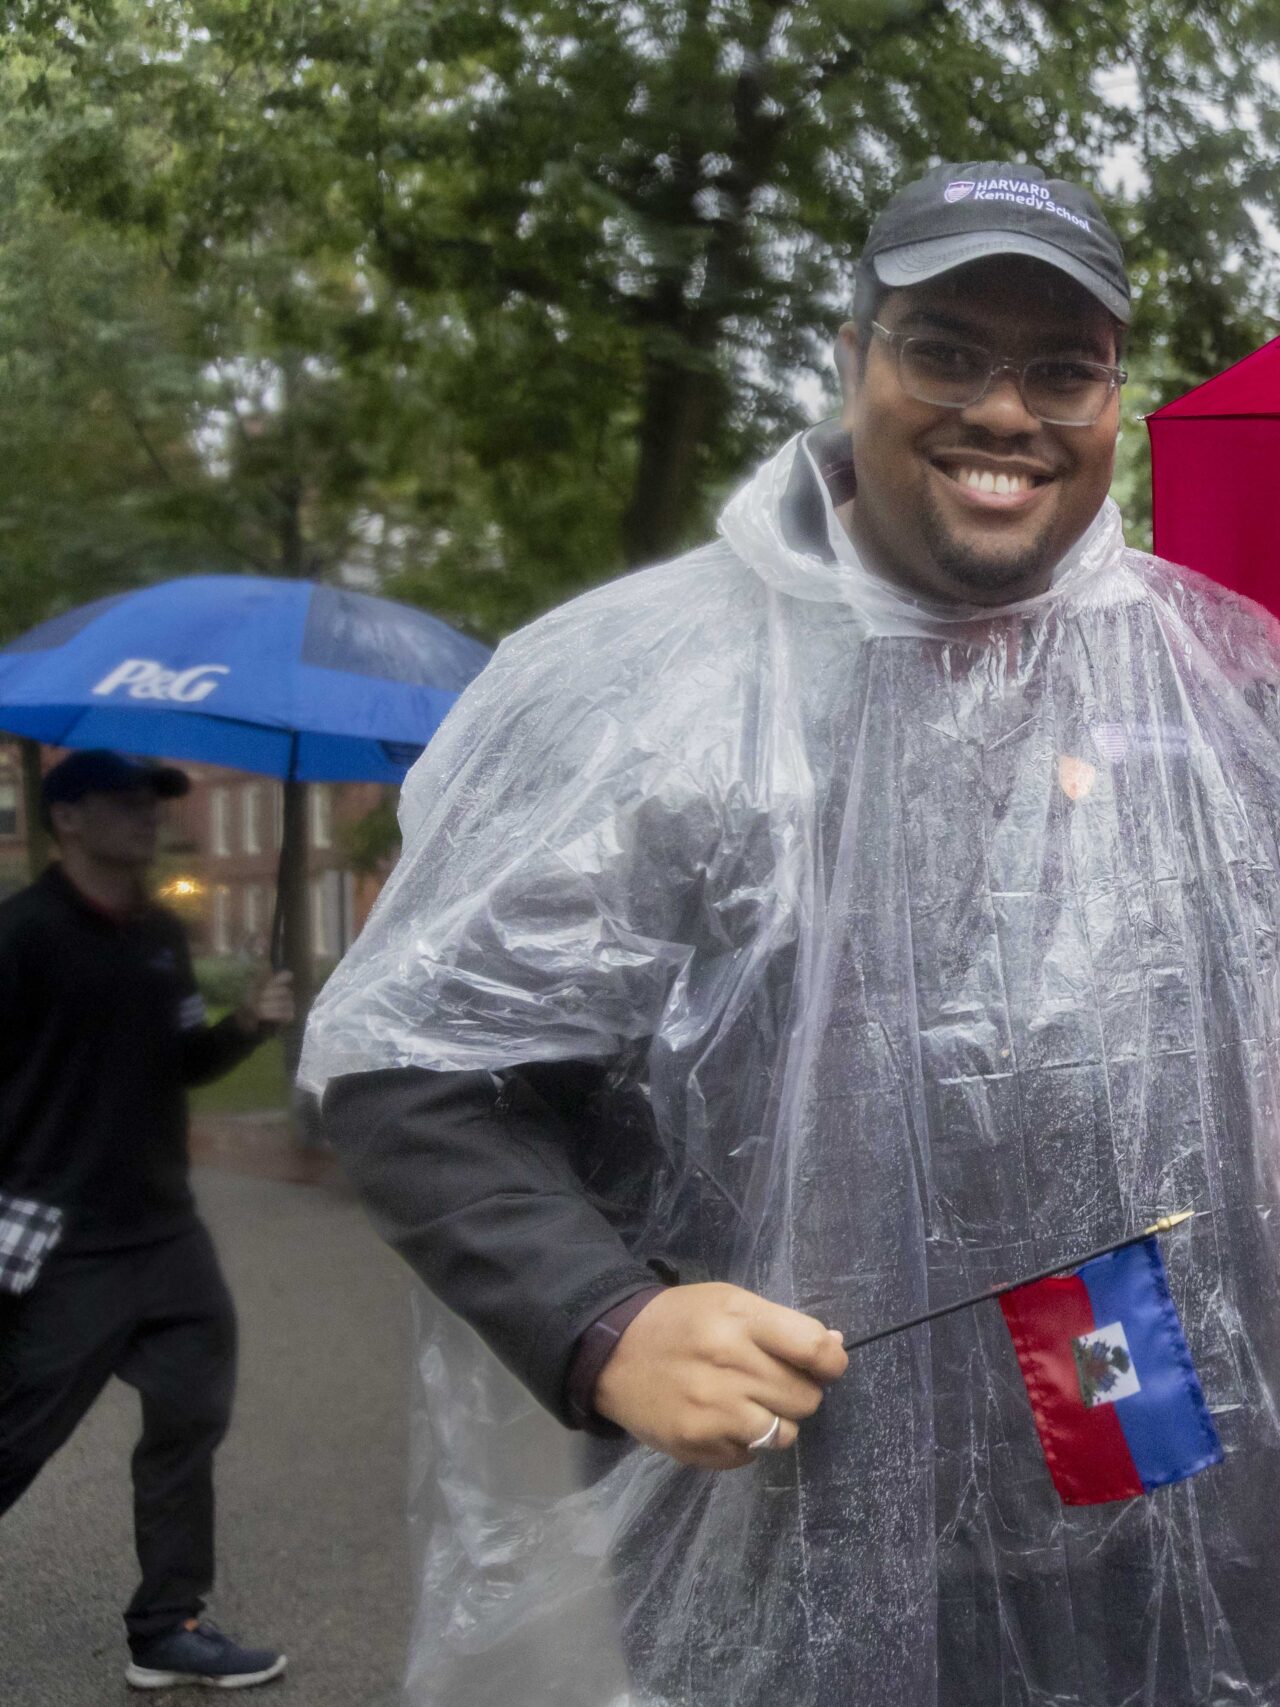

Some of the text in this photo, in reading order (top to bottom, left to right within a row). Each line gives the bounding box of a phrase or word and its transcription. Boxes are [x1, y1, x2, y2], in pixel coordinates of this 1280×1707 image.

[977, 180, 1050, 200] HARVARD
[974, 191, 1092, 233] Kennedy School
[92, 659, 230, 702] P&G
